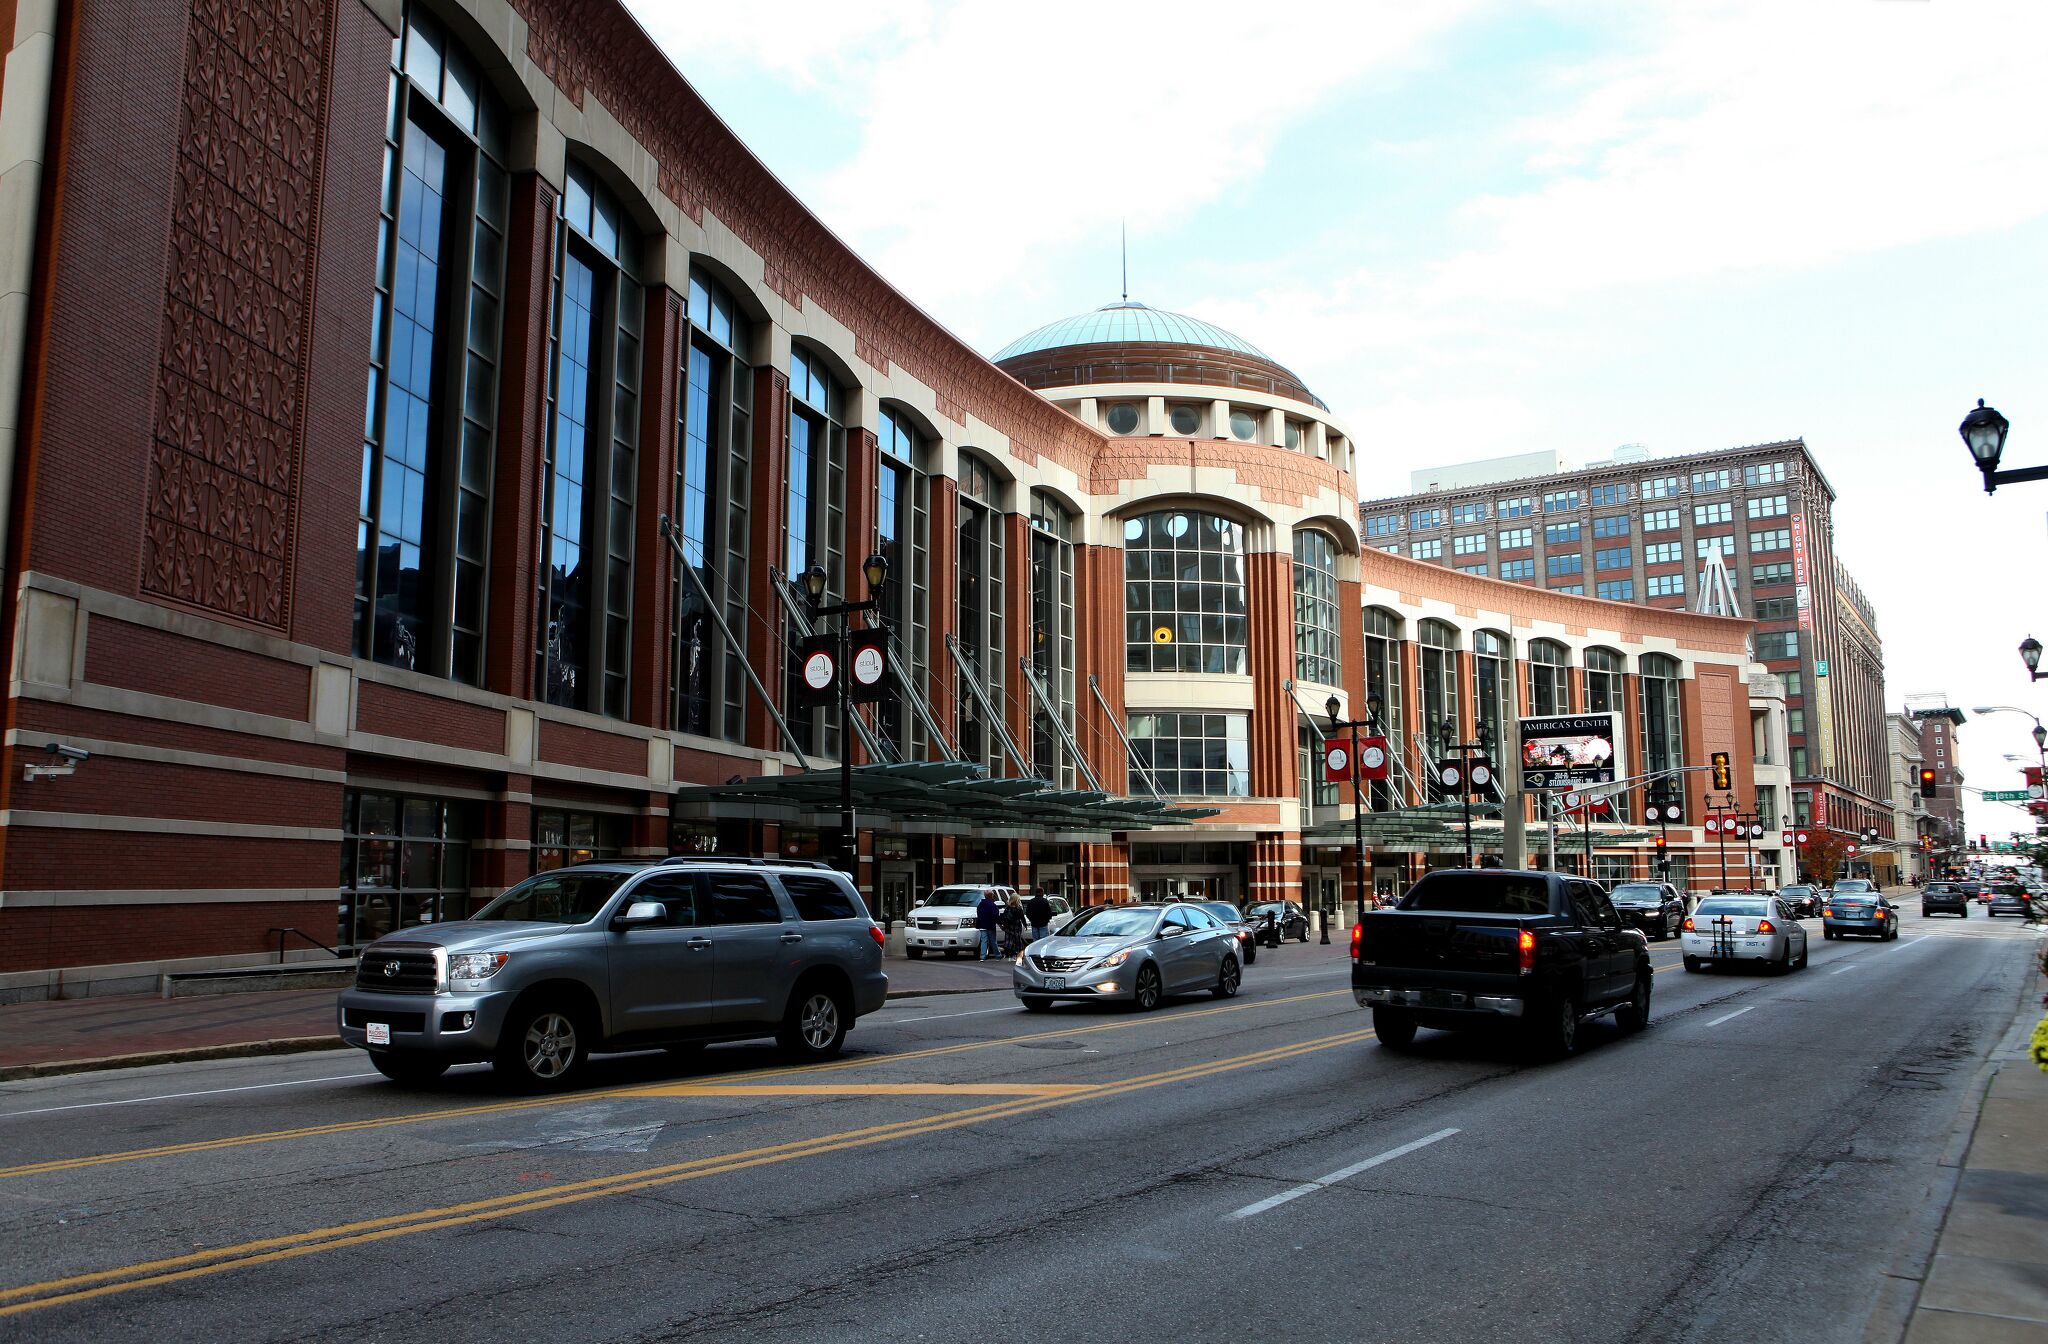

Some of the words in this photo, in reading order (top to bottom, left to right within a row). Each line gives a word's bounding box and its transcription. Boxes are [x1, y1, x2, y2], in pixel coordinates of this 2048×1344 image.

[1793, 523, 1803, 555] RIGHT
[1796, 558, 1805, 583] HERE
[1524, 720, 1571, 731] AMERICA'S
[1574, 719, 1609, 728] CENTER
